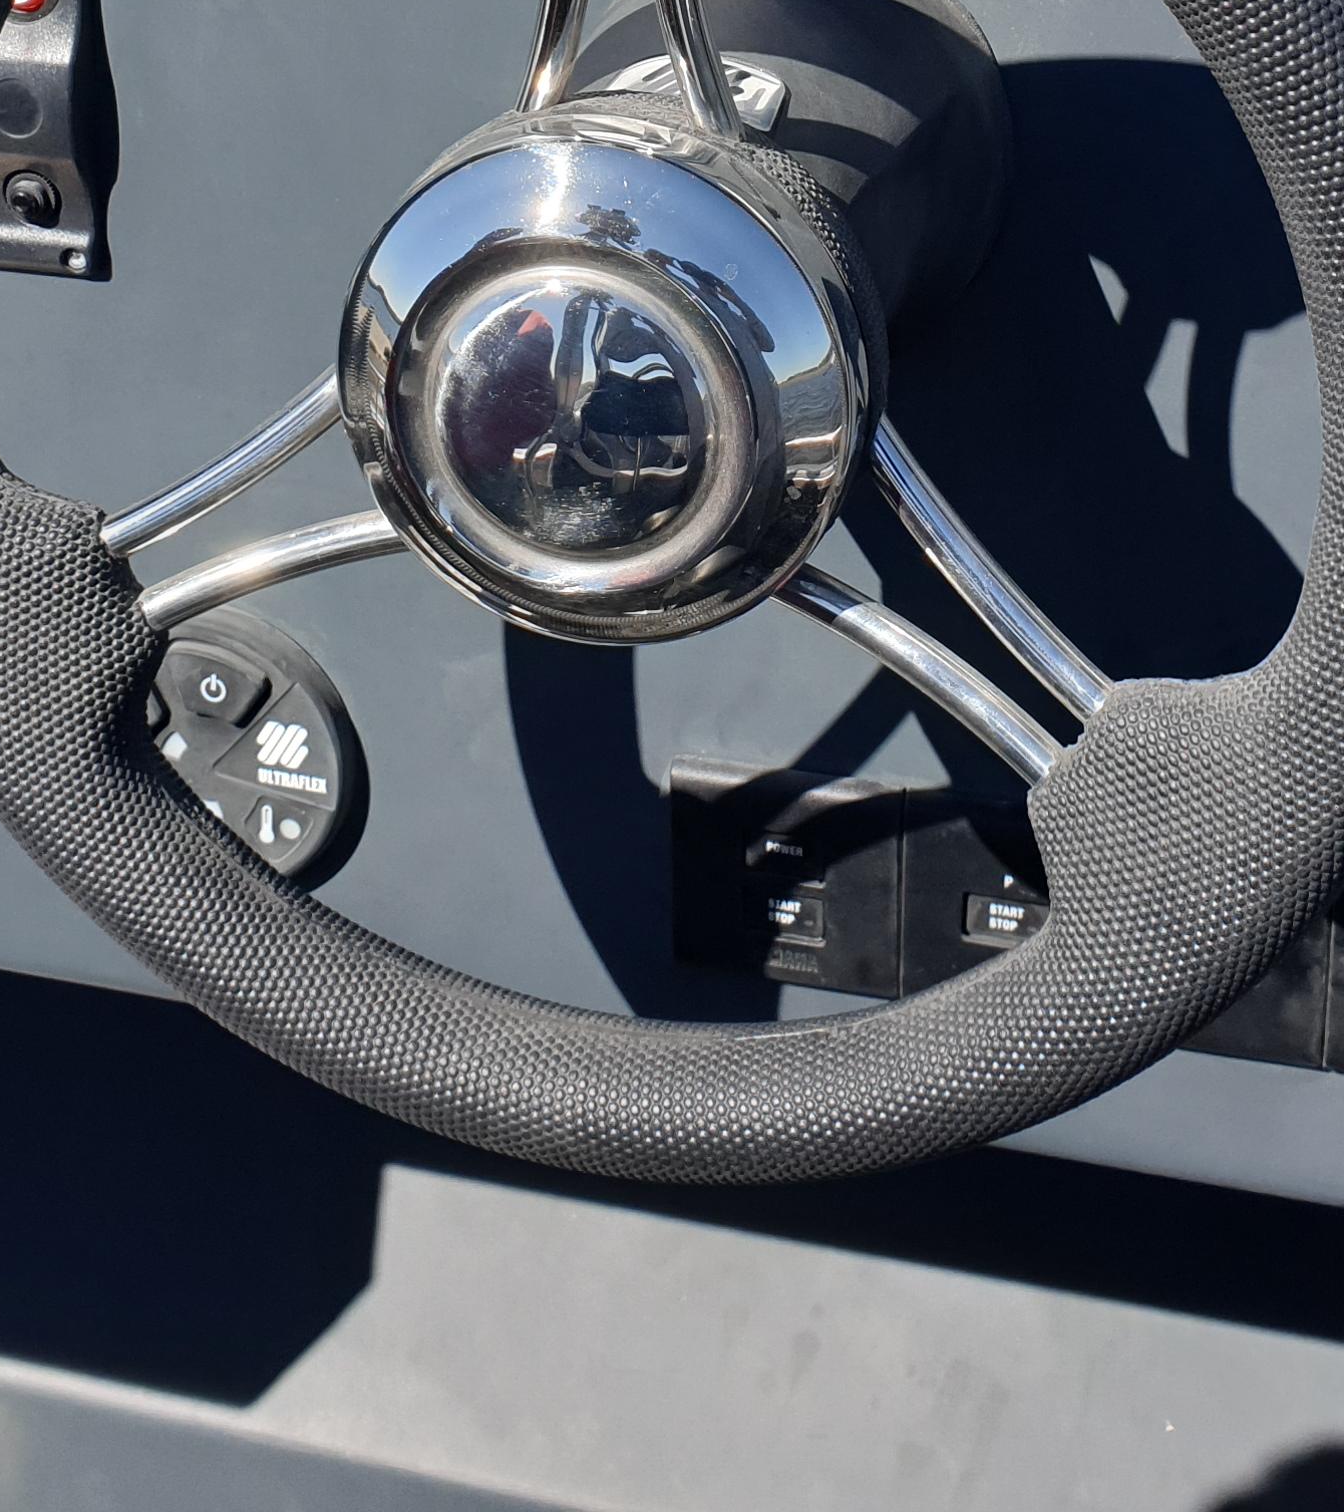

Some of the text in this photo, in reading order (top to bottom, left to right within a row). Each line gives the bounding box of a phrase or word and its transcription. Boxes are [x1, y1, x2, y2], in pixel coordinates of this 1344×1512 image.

[257, 768, 327, 794] ULTRAFLEX
[765, 840, 803, 857] POWER
[768, 897, 801, 913] START
[989, 903, 1025, 919] START
[768, 911, 796, 925] STOP
[988, 917, 1019, 931] STOP
